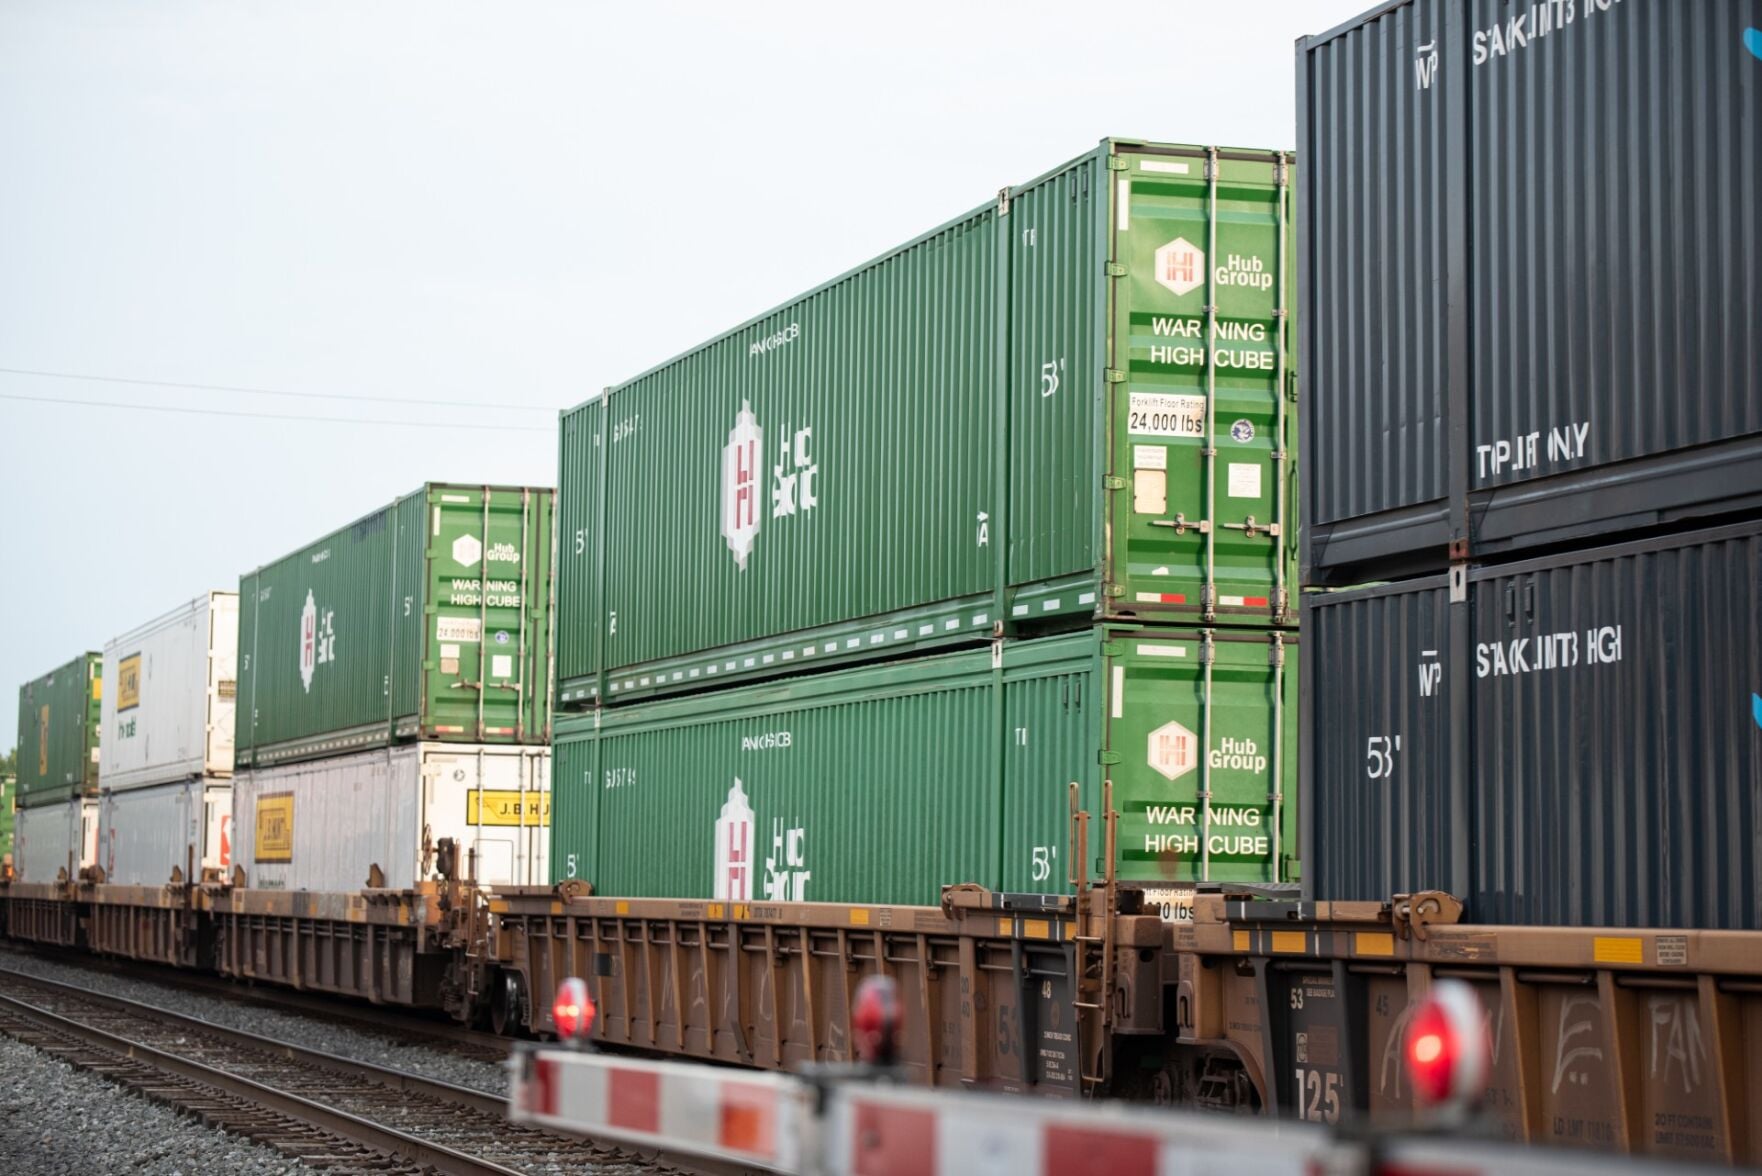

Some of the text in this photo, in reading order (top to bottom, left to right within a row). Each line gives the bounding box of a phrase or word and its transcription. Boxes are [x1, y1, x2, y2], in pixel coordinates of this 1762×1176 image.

[1228, 254, 1263, 273] Hub
[1215, 266, 1273, 291] Group
[1152, 316, 1265, 342] WARNING
[1151, 345, 1274, 370] HIGH CUBE
[1160, 398, 1179, 409] Floor
[1130, 412, 1203, 433] 24,000 lbs
[487, 549, 520, 564] Group
[494, 542, 515, 554] Hub
[452, 578, 517, 593] WARNING
[450, 593, 520, 607] HIGH CUBE
[1221, 737, 1257, 756] Hub
[1209, 750, 1266, 774] Group
[1146, 806, 1260, 827] WARNING
[1145, 834, 1268, 856] HIGH CUBE
[1290, 987, 1304, 1010] 53
